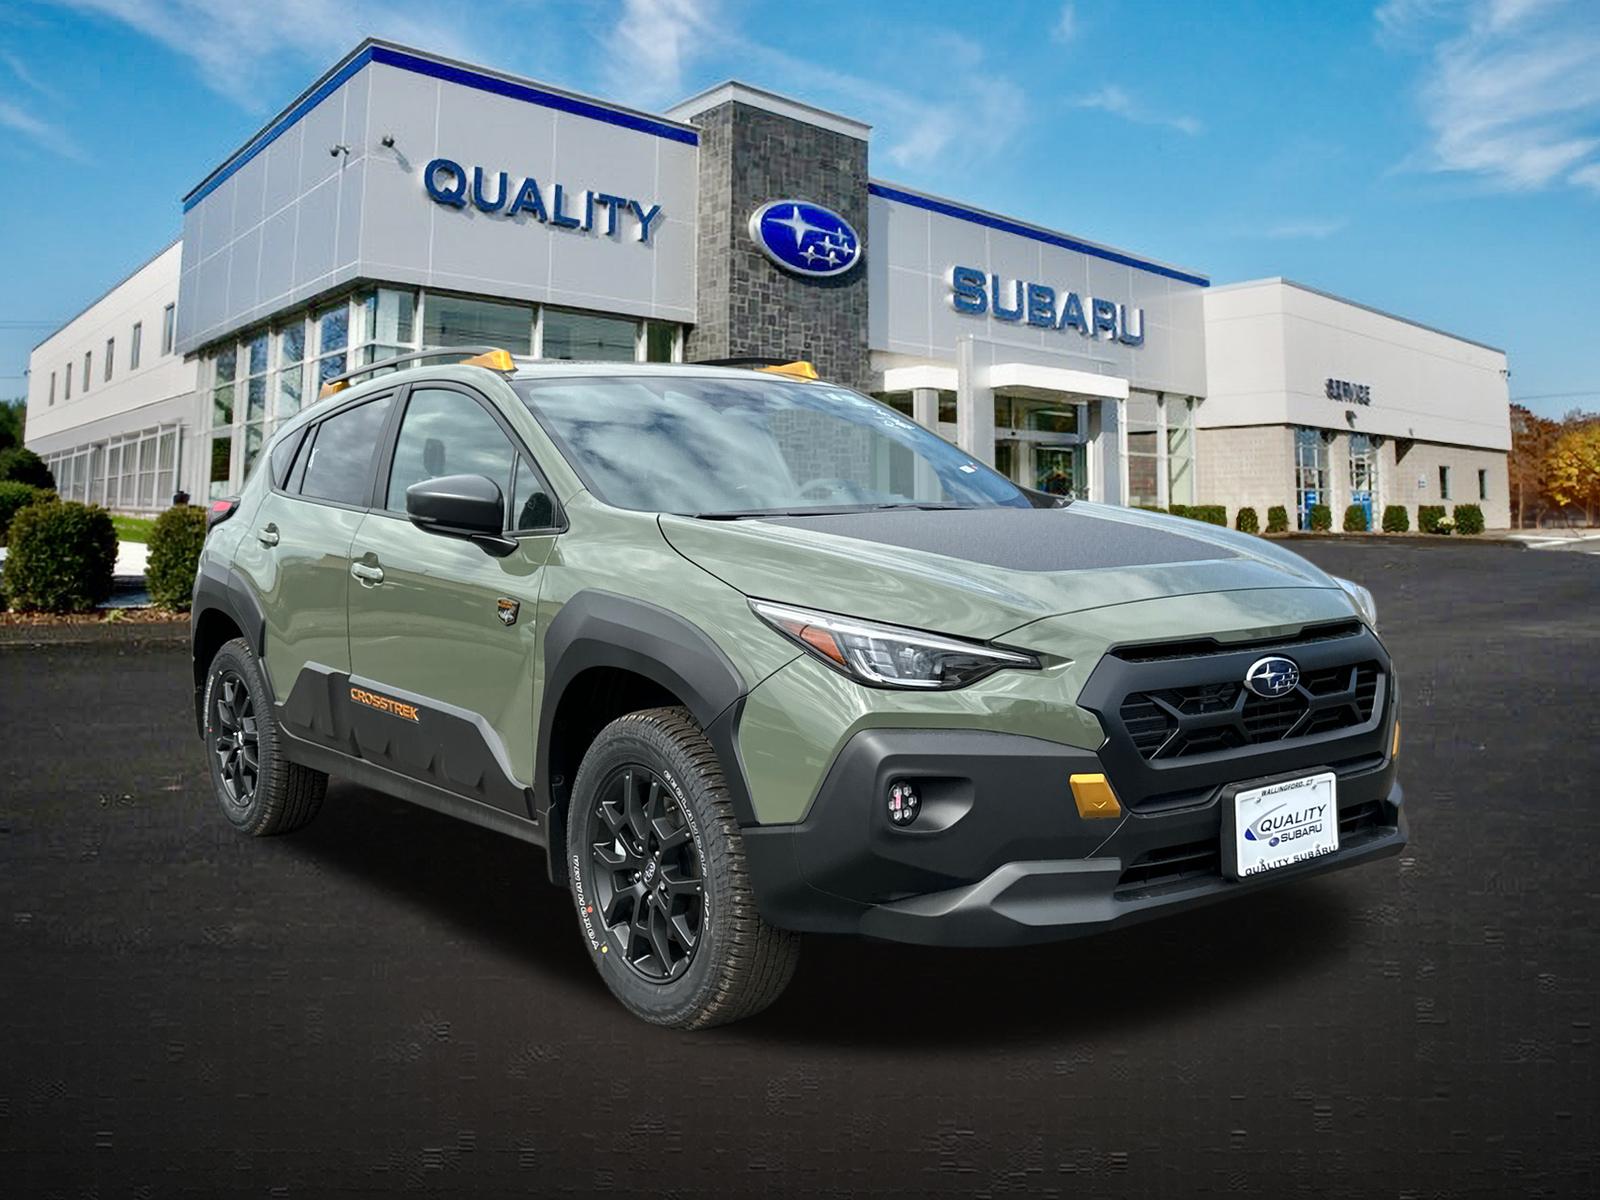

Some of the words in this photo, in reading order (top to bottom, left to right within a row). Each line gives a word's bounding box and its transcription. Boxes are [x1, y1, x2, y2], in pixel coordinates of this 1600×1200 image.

[424, 158, 661, 242] QUALITY
[951, 265, 1144, 346] SUBARU
[1325, 378, 1371, 406] SERVICE
[350, 687, 420, 722] CROSSTREK
[1260, 803, 1327, 832] QUALITY
[1280, 823, 1323, 843] SUBARU
[1245, 857, 1290, 876] QUALITY
[1293, 845, 1336, 863] SUBARU
